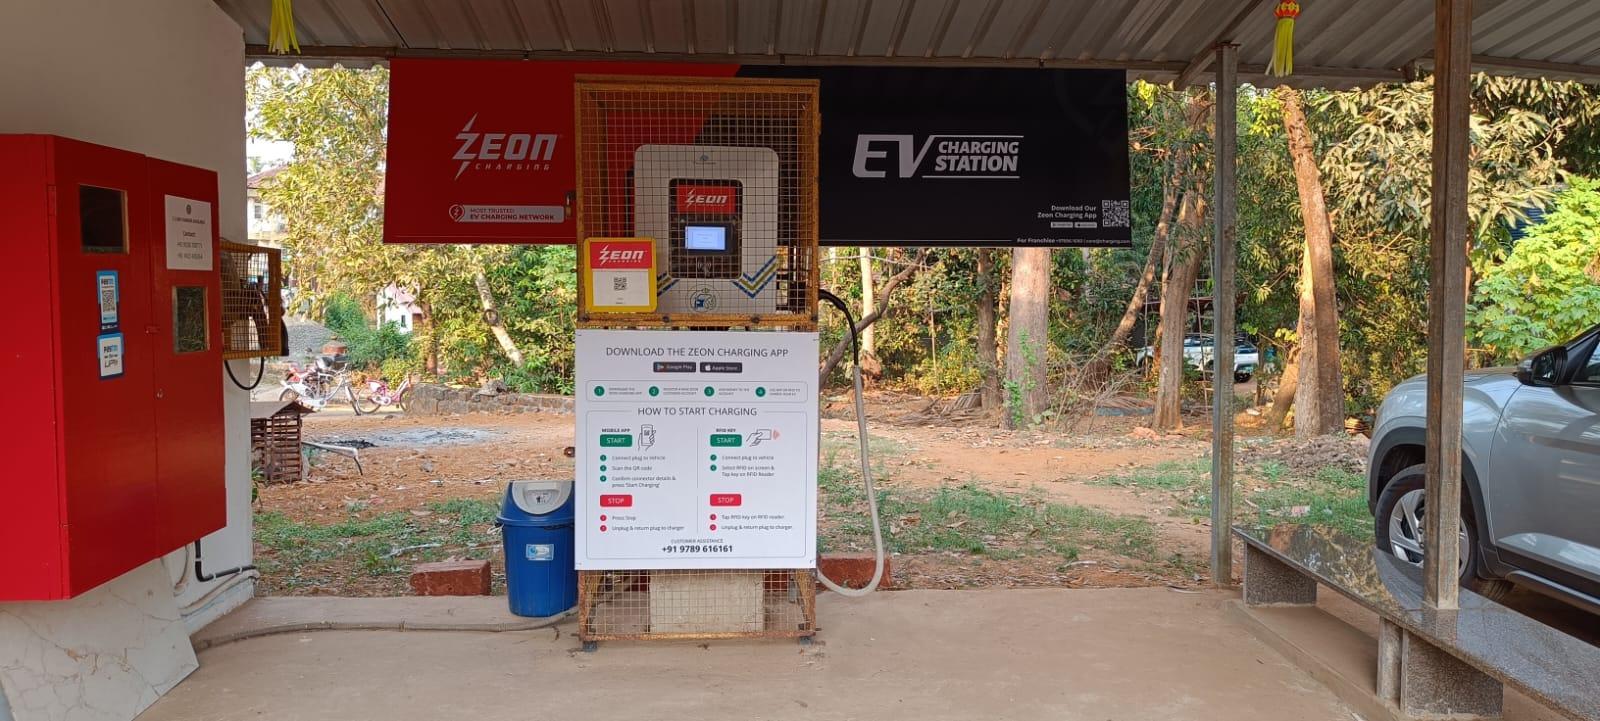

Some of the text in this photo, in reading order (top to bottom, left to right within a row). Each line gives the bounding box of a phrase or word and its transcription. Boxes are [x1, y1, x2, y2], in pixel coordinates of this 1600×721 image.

[452, 112, 558, 180] ZEON
[938, 142, 1019, 154] CHARGING
[852, 134, 936, 178] EV
[935, 156, 1018, 172] STATION
[606, 347, 788, 357] DOWNLOAD THE ZEON CHARGING APP
[638, 407, 757, 416] HOW TO START CHARGING
